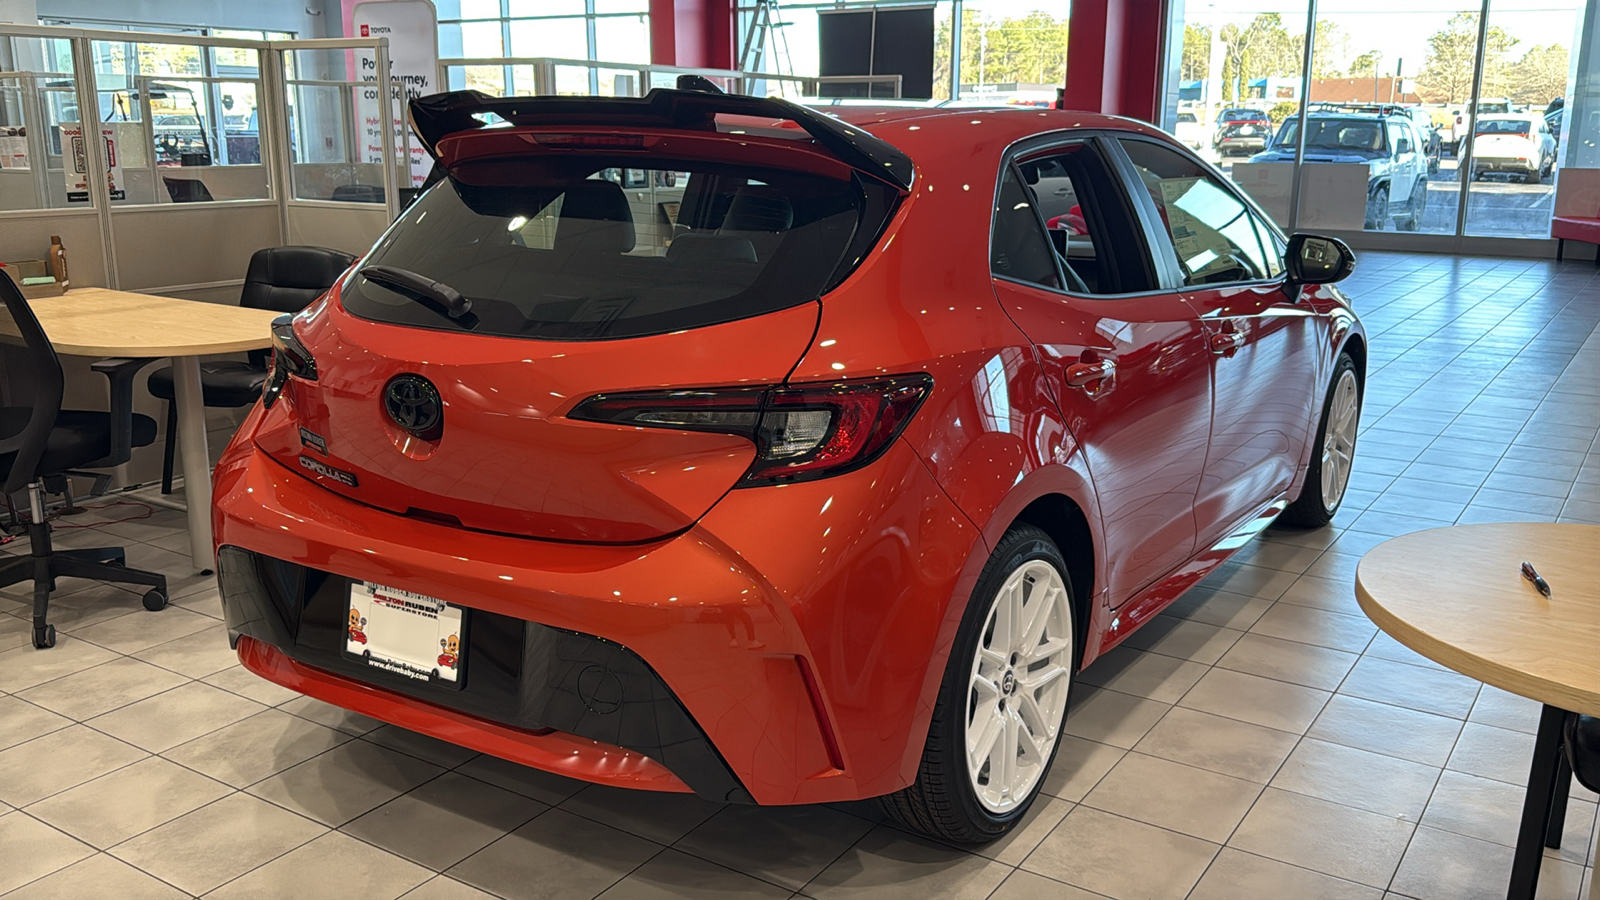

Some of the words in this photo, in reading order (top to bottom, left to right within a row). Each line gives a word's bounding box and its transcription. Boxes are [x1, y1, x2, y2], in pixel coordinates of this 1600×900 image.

[362, 58, 393, 69] Por
[390, 75, 428, 88] ourney,
[299, 456, 342, 482] COROLLA
[373, 593, 405, 605] MILTON
[405, 601, 439, 614] RUBEN
[386, 603, 438, 619] SUPERSTORE
[368, 660, 430, 682] www.drivebaby.com
